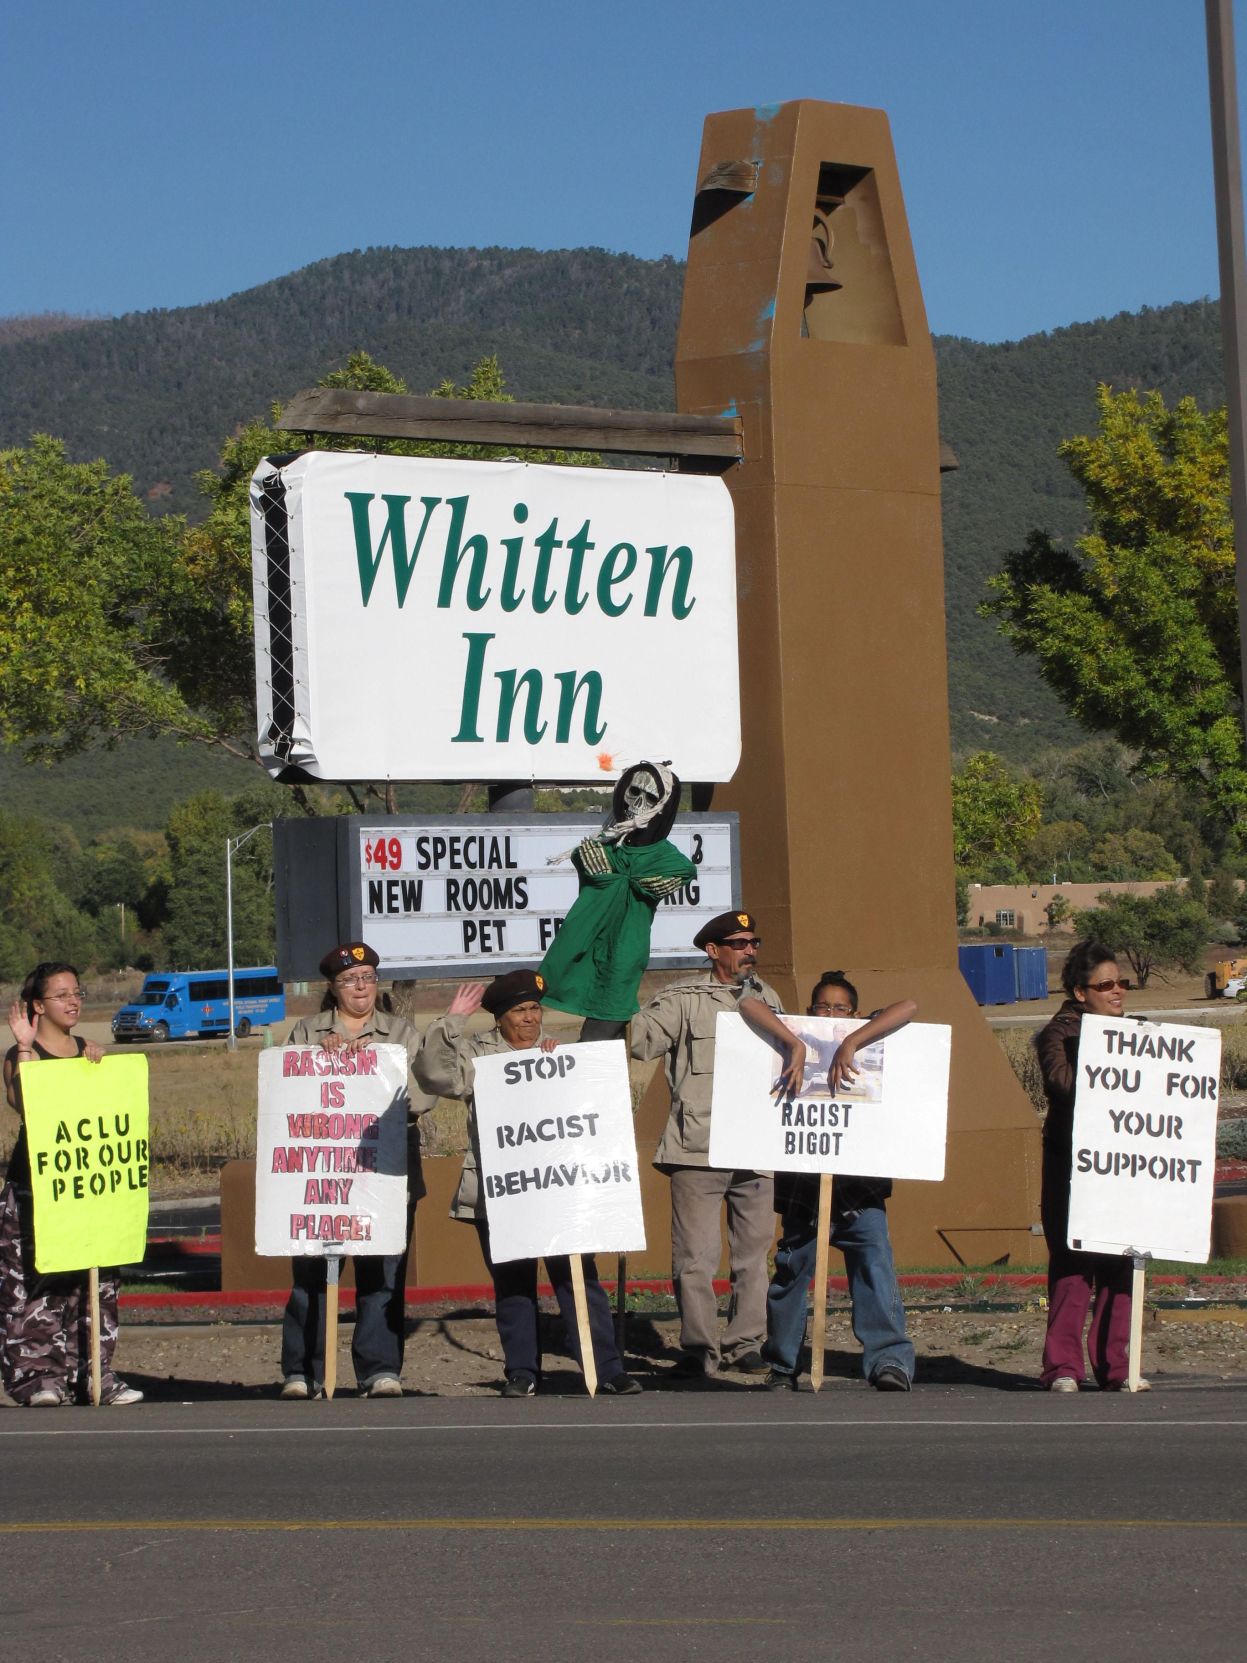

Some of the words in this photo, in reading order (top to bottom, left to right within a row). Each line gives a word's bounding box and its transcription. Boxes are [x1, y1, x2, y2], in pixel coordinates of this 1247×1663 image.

[344, 491, 697, 621] Whitten
[450, 632, 608, 746] Inn
[365, 837, 402, 871] $49
[416, 835, 518, 871] SPECIAL
[368, 879, 423, 914] NEW
[446, 876, 529, 912] ROOMS
[463, 919, 506, 953] PET
[1102, 1029, 1196, 1063] THANK
[283, 1049, 378, 1077] RACISM
[503, 1054, 576, 1085] STOP
[320, 1081, 346, 1108] IS
[1085, 1064, 1141, 1093] YOU
[1166, 1072, 1217, 1100] FOR
[55, 1113, 130, 1144] ACLU
[287, 1112, 380, 1140] WRONG
[496, 1113, 600, 1149] RACIST
[781, 1102, 852, 1128] RACIST
[1108, 1109, 1183, 1140] YOUR
[37, 1147, 90, 1175] FOR
[98, 1138, 148, 1167] OUR
[784, 1131, 843, 1156] BIGOT
[271, 1146, 378, 1174] ANYTIME
[1077, 1149, 1202, 1184] SUPPORT
[52, 1165, 148, 1202] PEOPLE
[303, 1178, 354, 1205] ANY
[290, 1213, 372, 1241] PLACE!
